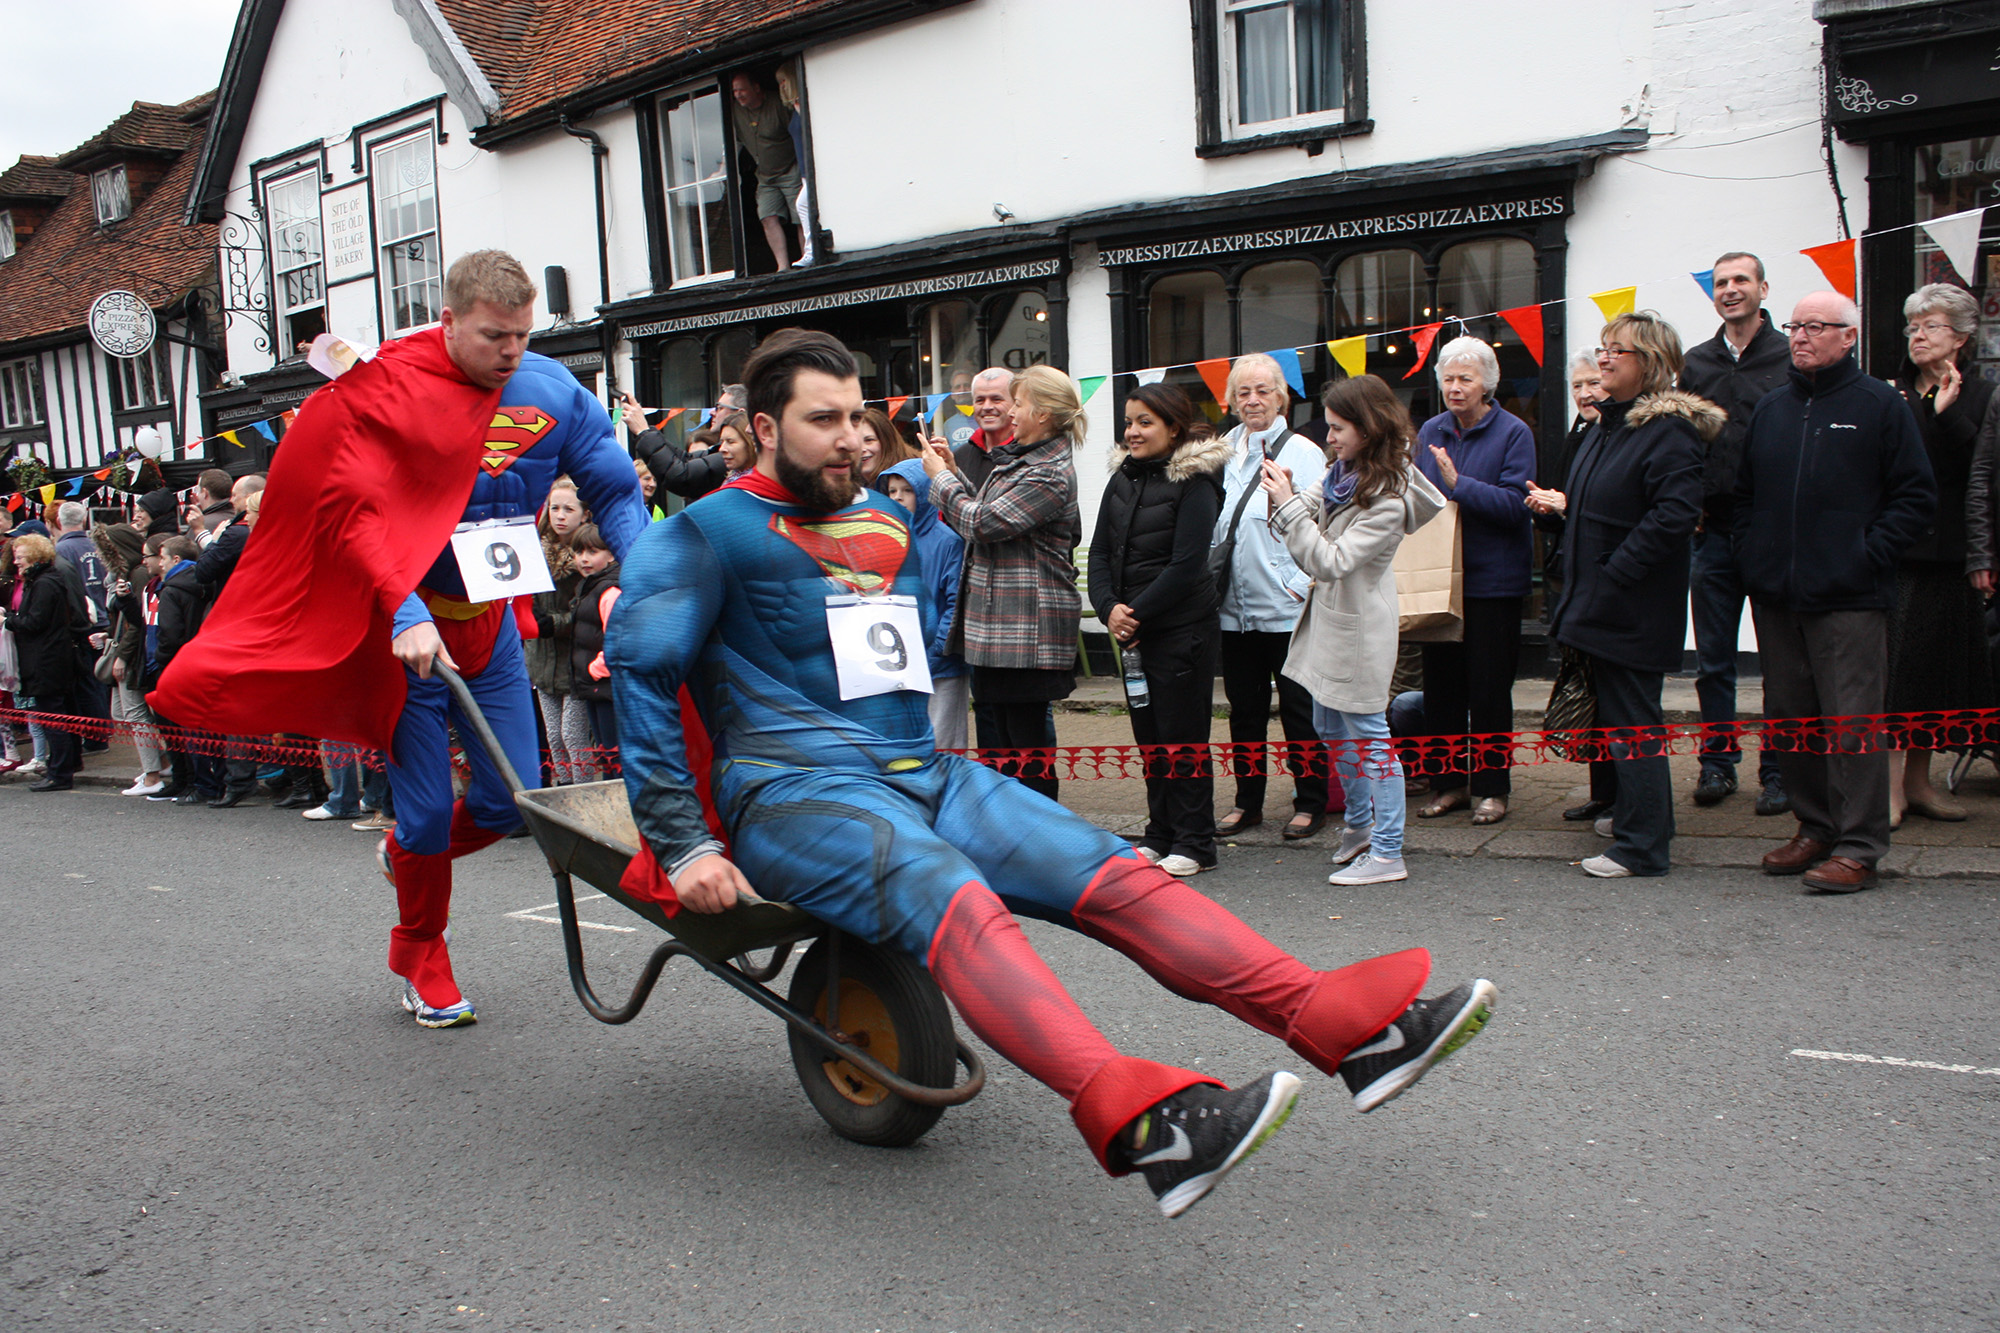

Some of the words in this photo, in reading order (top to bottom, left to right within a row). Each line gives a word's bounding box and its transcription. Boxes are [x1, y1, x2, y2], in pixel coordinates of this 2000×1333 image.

[332, 202, 348, 217] SITE
[350, 198, 360, 211] OF
[331, 219, 347, 235] THE
[348, 214, 364, 229] OLD
[332, 232, 365, 250] VILLAGE
[334, 249, 365, 267] BAKERY
[101, 321, 146, 332] EXPRESS
[108, 313, 137, 323] PIZZA
[86, 558, 97, 580] 1
[484, 542, 521, 582] 9
[867, 621, 908, 672] 9
